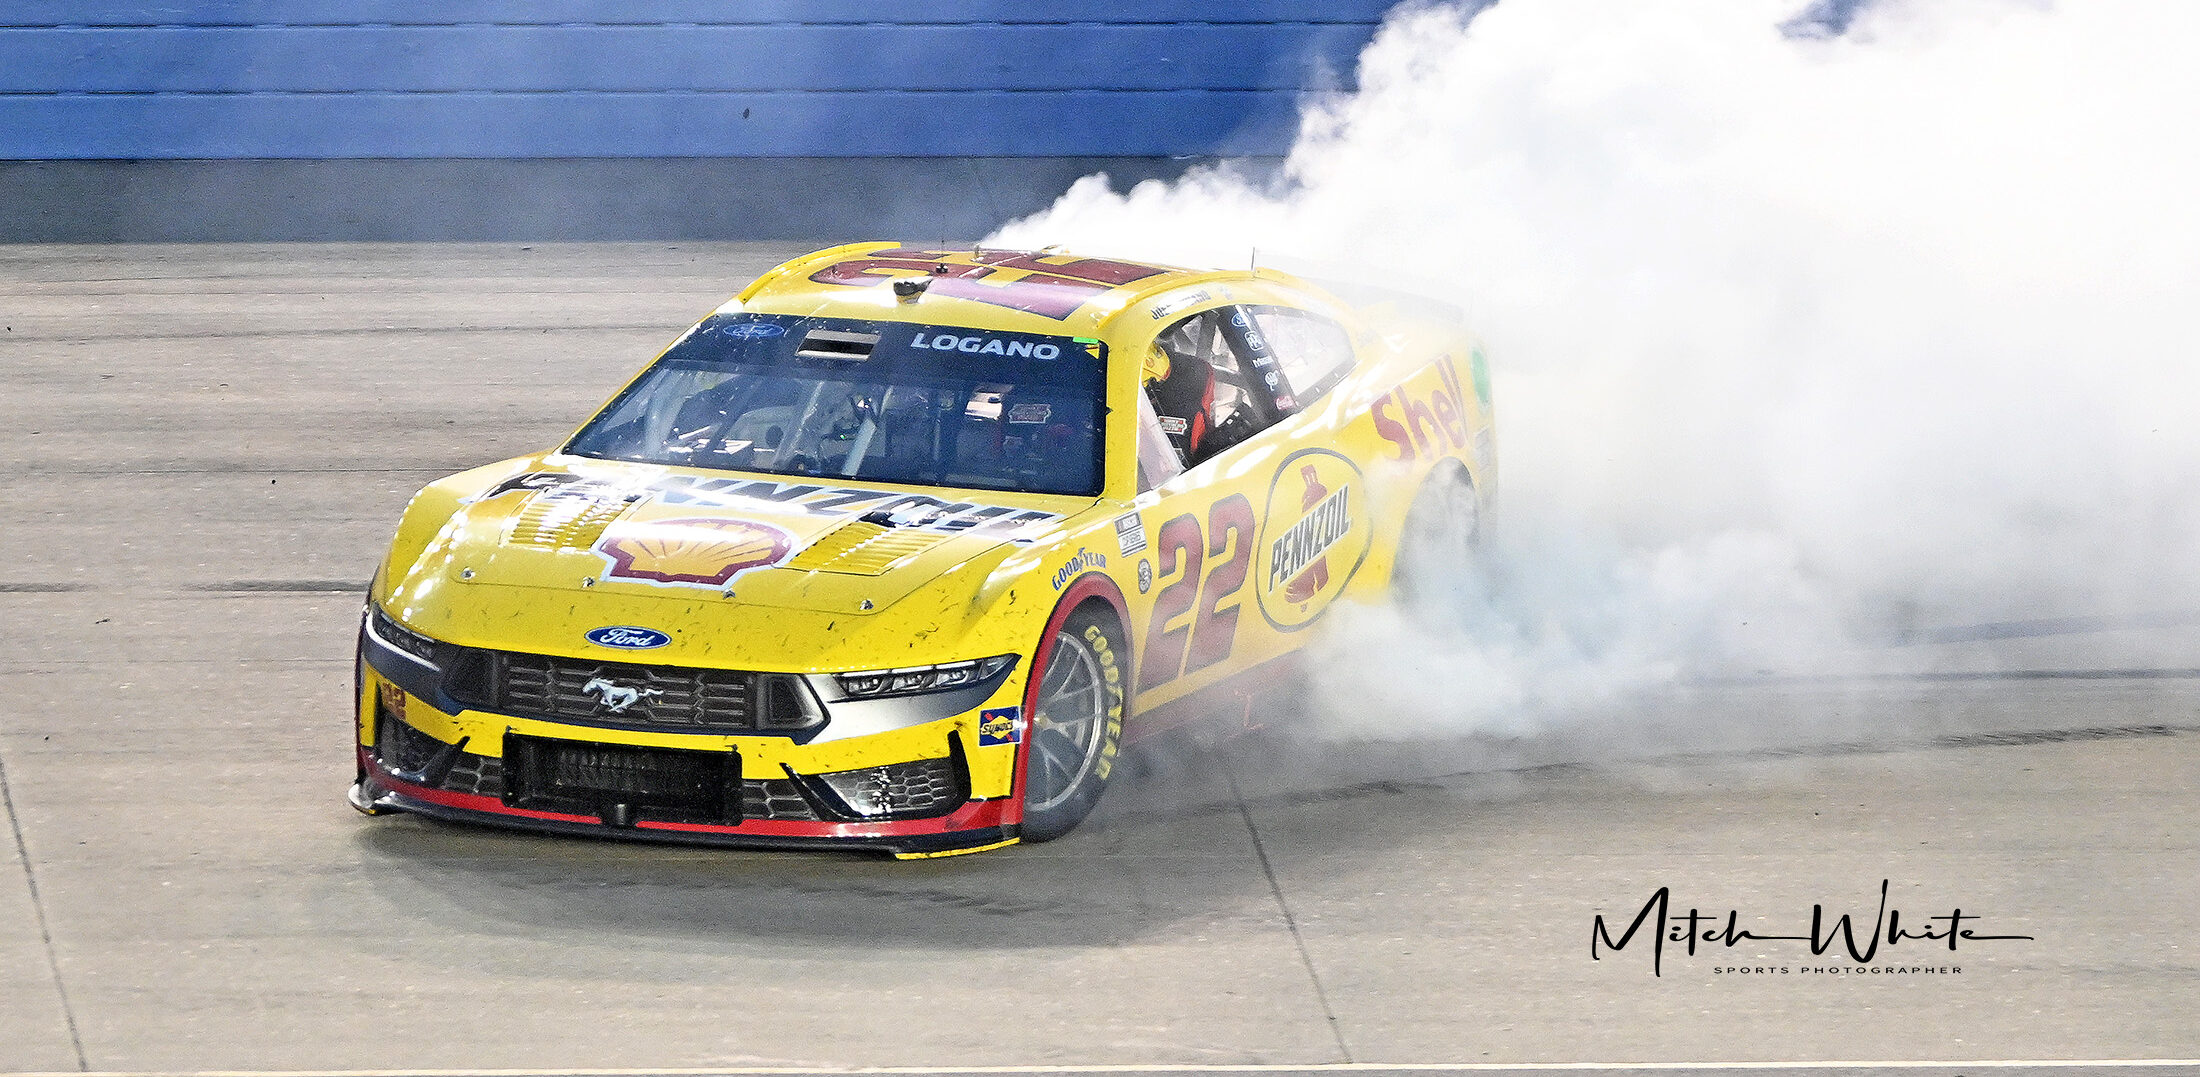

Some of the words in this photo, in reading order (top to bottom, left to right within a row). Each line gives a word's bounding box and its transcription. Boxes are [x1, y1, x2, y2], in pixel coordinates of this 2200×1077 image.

[911, 332, 1060, 360] LOGANO
[1051, 547, 1107, 591] GOODYEAR
[1136, 493, 1255, 693] 22
[1268, 484, 1350, 594] PENNZOIL
[1083, 625, 1124, 781] GOODYEAR
